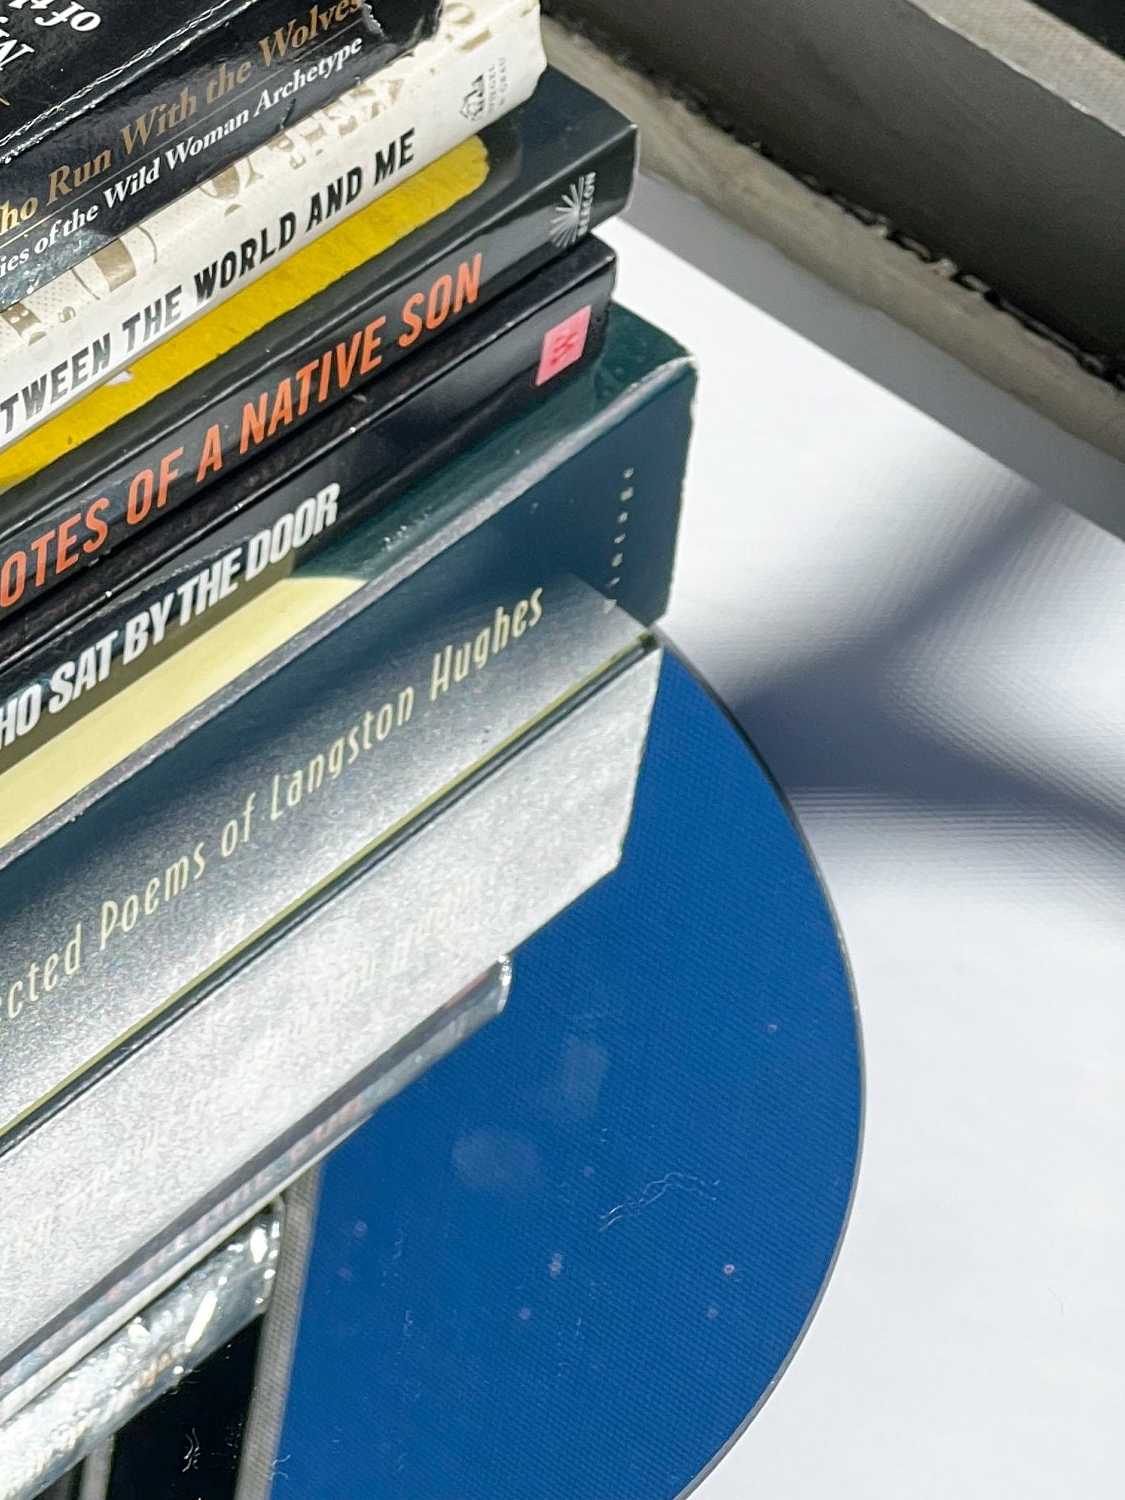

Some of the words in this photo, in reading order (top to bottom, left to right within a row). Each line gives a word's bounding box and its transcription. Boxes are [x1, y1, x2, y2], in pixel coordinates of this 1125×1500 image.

[34, 1, 101, 31] of
[34, 219, 65, 256] of
[64, 201, 98, 236] the
[103, 160, 160, 210] Wild
[165, 109, 249, 171] Woman
[253, 37, 363, 117] Archetype
[46, 148, 113, 206] Run
[120, 87, 197, 155] With
[206, 64, 252, 103] the
[121, 284, 184, 353] THE
[192, 211, 297, 304] WORLD
[306, 166, 363, 233] AND
[374, 127, 415, 186] ME
[125, 447, 184, 525] OF
[195, 424, 223, 482] A
[239, 315, 387, 455] NATIVE
[398, 253, 482, 347] SON
[47, 629, 121, 714] SAT
[122, 597, 177, 667] BY
[175, 547, 243, 627] THE
[245, 483, 341, 582] DOOR
[99, 841, 206, 951] Poems
[220, 792, 257, 857] of
[269, 685, 415, 823] Langston
[430, 587, 543, 702] Hughes
